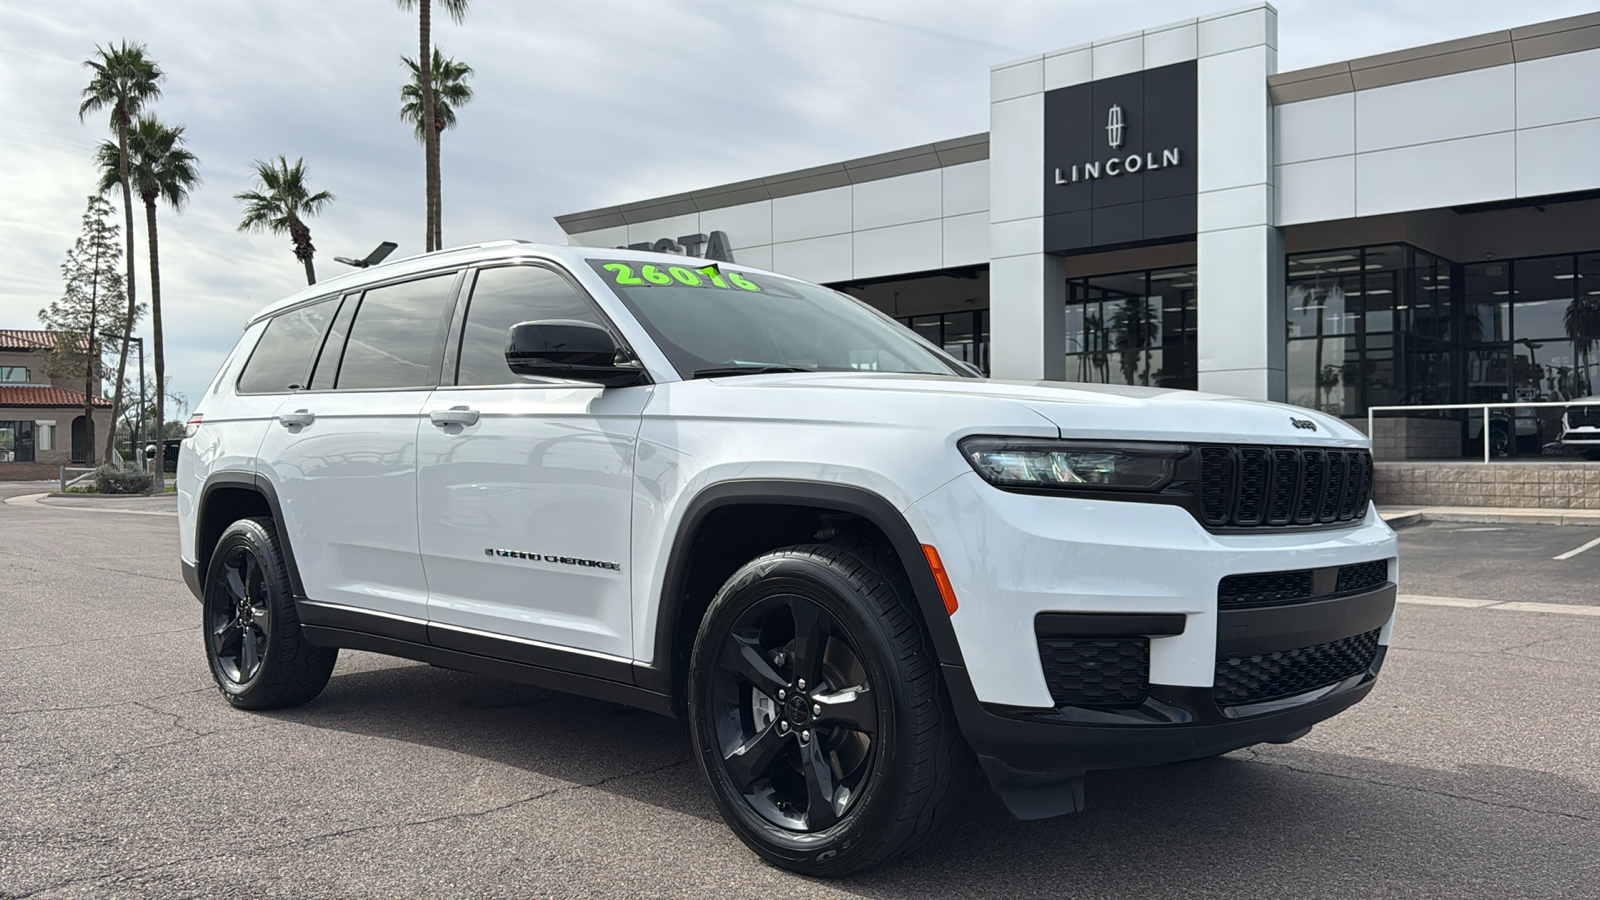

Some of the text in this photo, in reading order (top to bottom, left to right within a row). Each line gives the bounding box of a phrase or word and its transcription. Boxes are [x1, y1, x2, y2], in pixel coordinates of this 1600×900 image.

[1054, 147, 1179, 185] LINCOLN
[602, 263, 761, 292] 26076
[1289, 416, 1318, 432] Jeep
[496, 548, 622, 571] GRAND CHEROKEE
